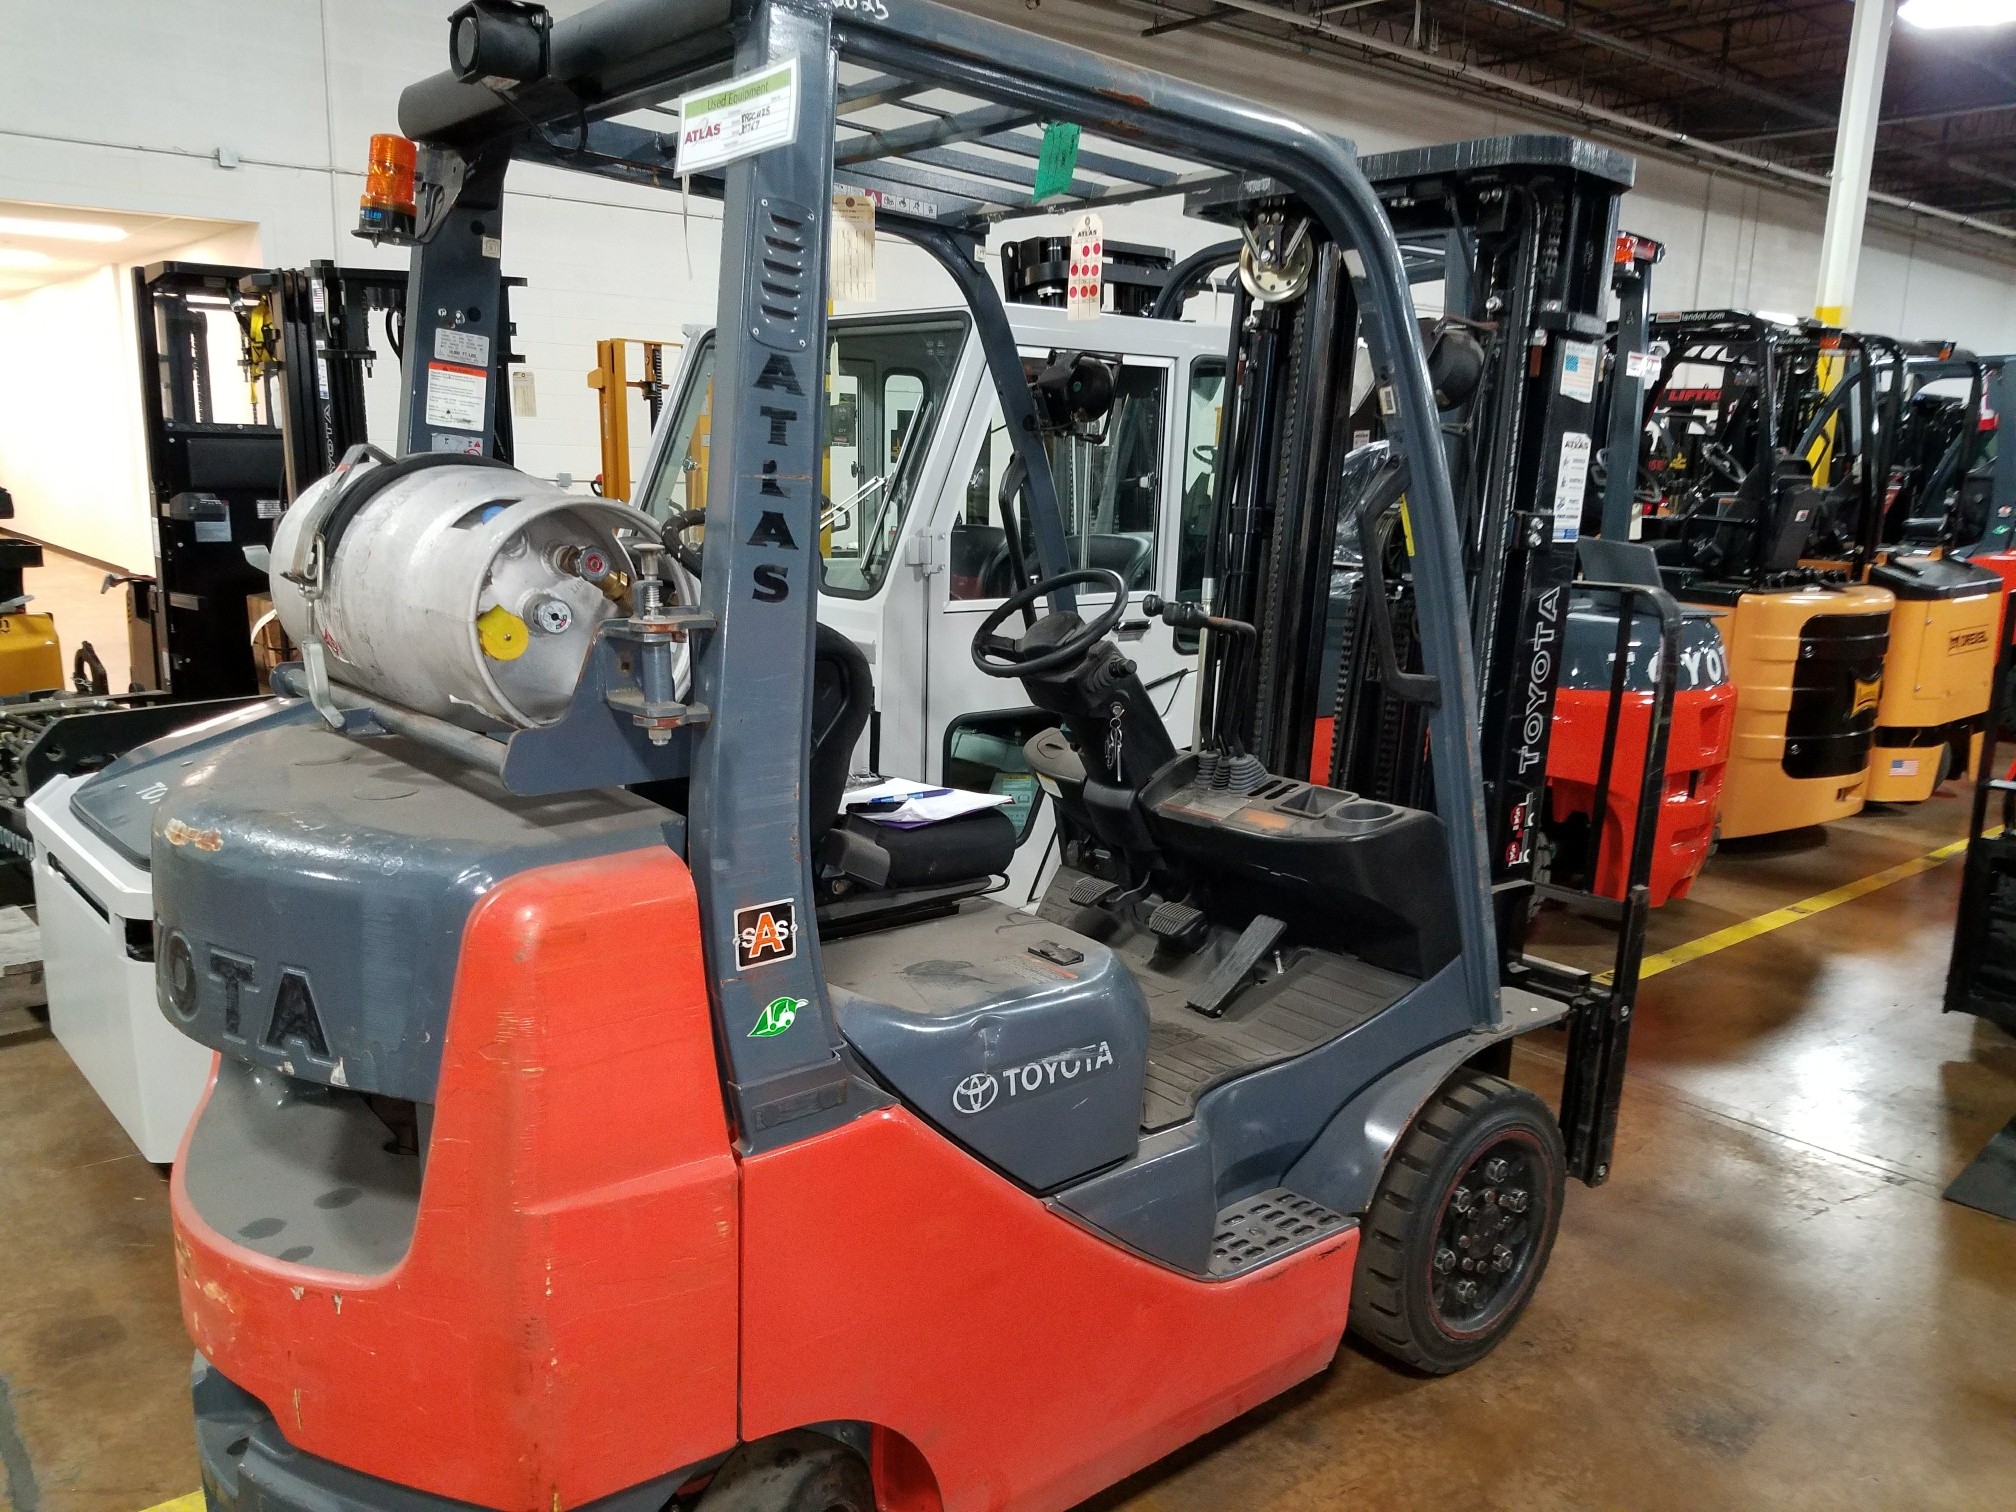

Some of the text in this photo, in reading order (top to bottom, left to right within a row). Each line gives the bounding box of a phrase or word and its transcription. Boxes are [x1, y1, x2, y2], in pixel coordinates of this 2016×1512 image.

[707, 94, 727, 110] Used
[728, 82, 769, 105] Equipment
[684, 123, 721, 144] ATLAS
[1077, 229, 1097, 238] ATLAS
[747, 352, 806, 603] ATLAS
[1518, 586, 1561, 774] TOYOTA
[155, 915, 335, 1066] OTA
[1002, 1041, 1114, 1097] TOYOTA
